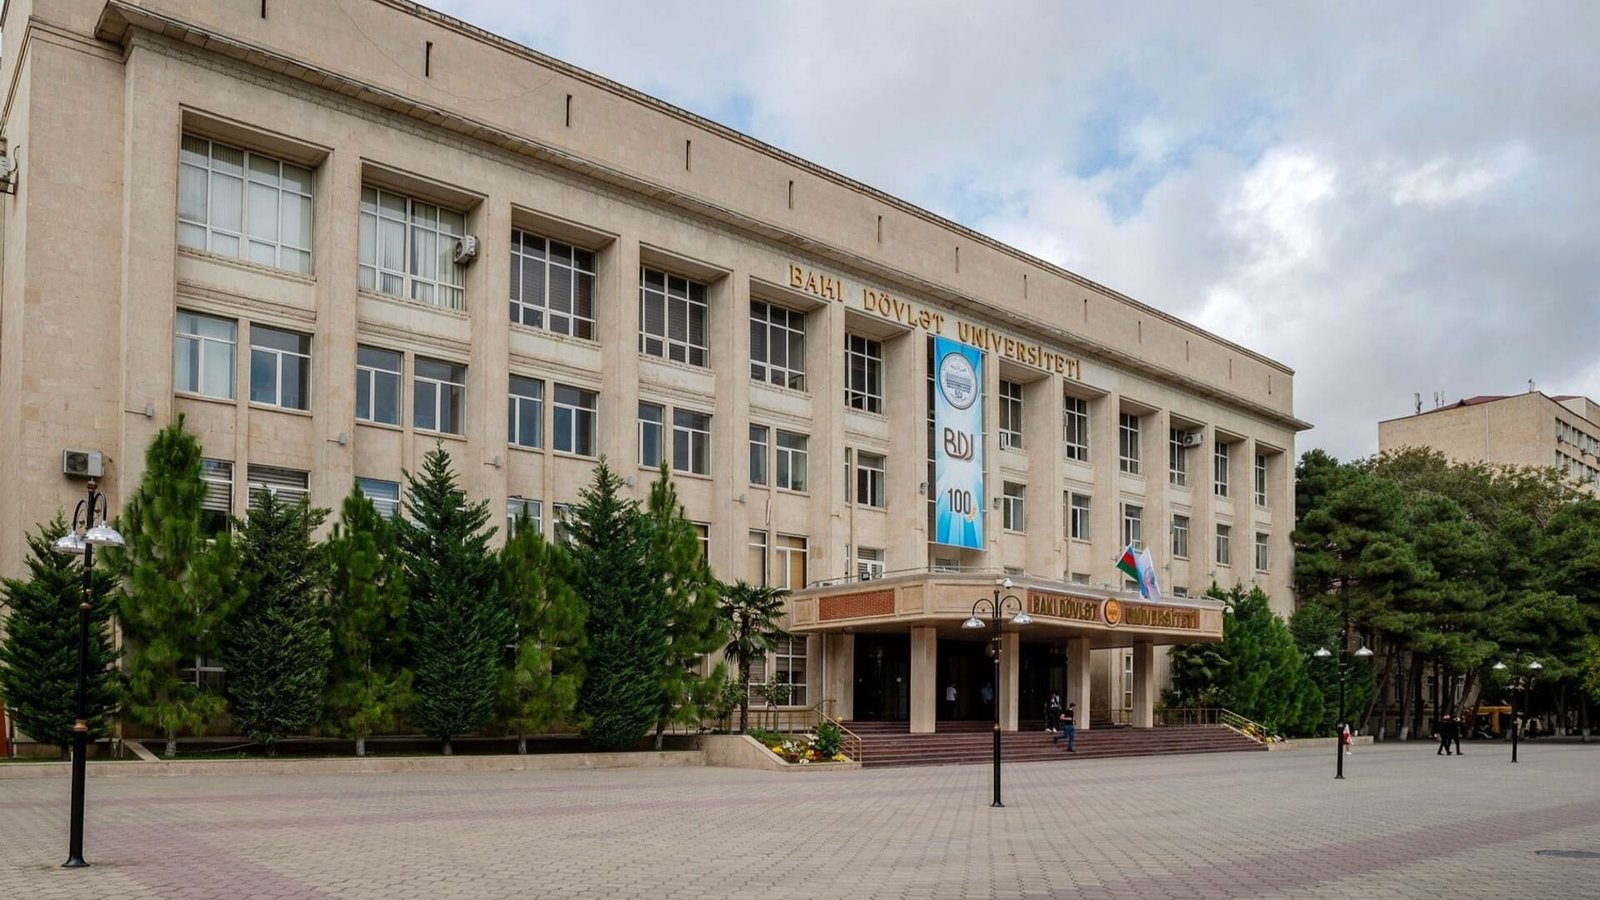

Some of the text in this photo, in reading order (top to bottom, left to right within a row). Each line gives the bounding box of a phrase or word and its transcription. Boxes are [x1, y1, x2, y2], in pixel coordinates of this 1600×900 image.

[789, 264, 844, 303] BAKI
[863, 288, 944, 334] DÖVLƏT
[948, 488, 971, 515] 100
[1032, 595, 1056, 615] BAKI
